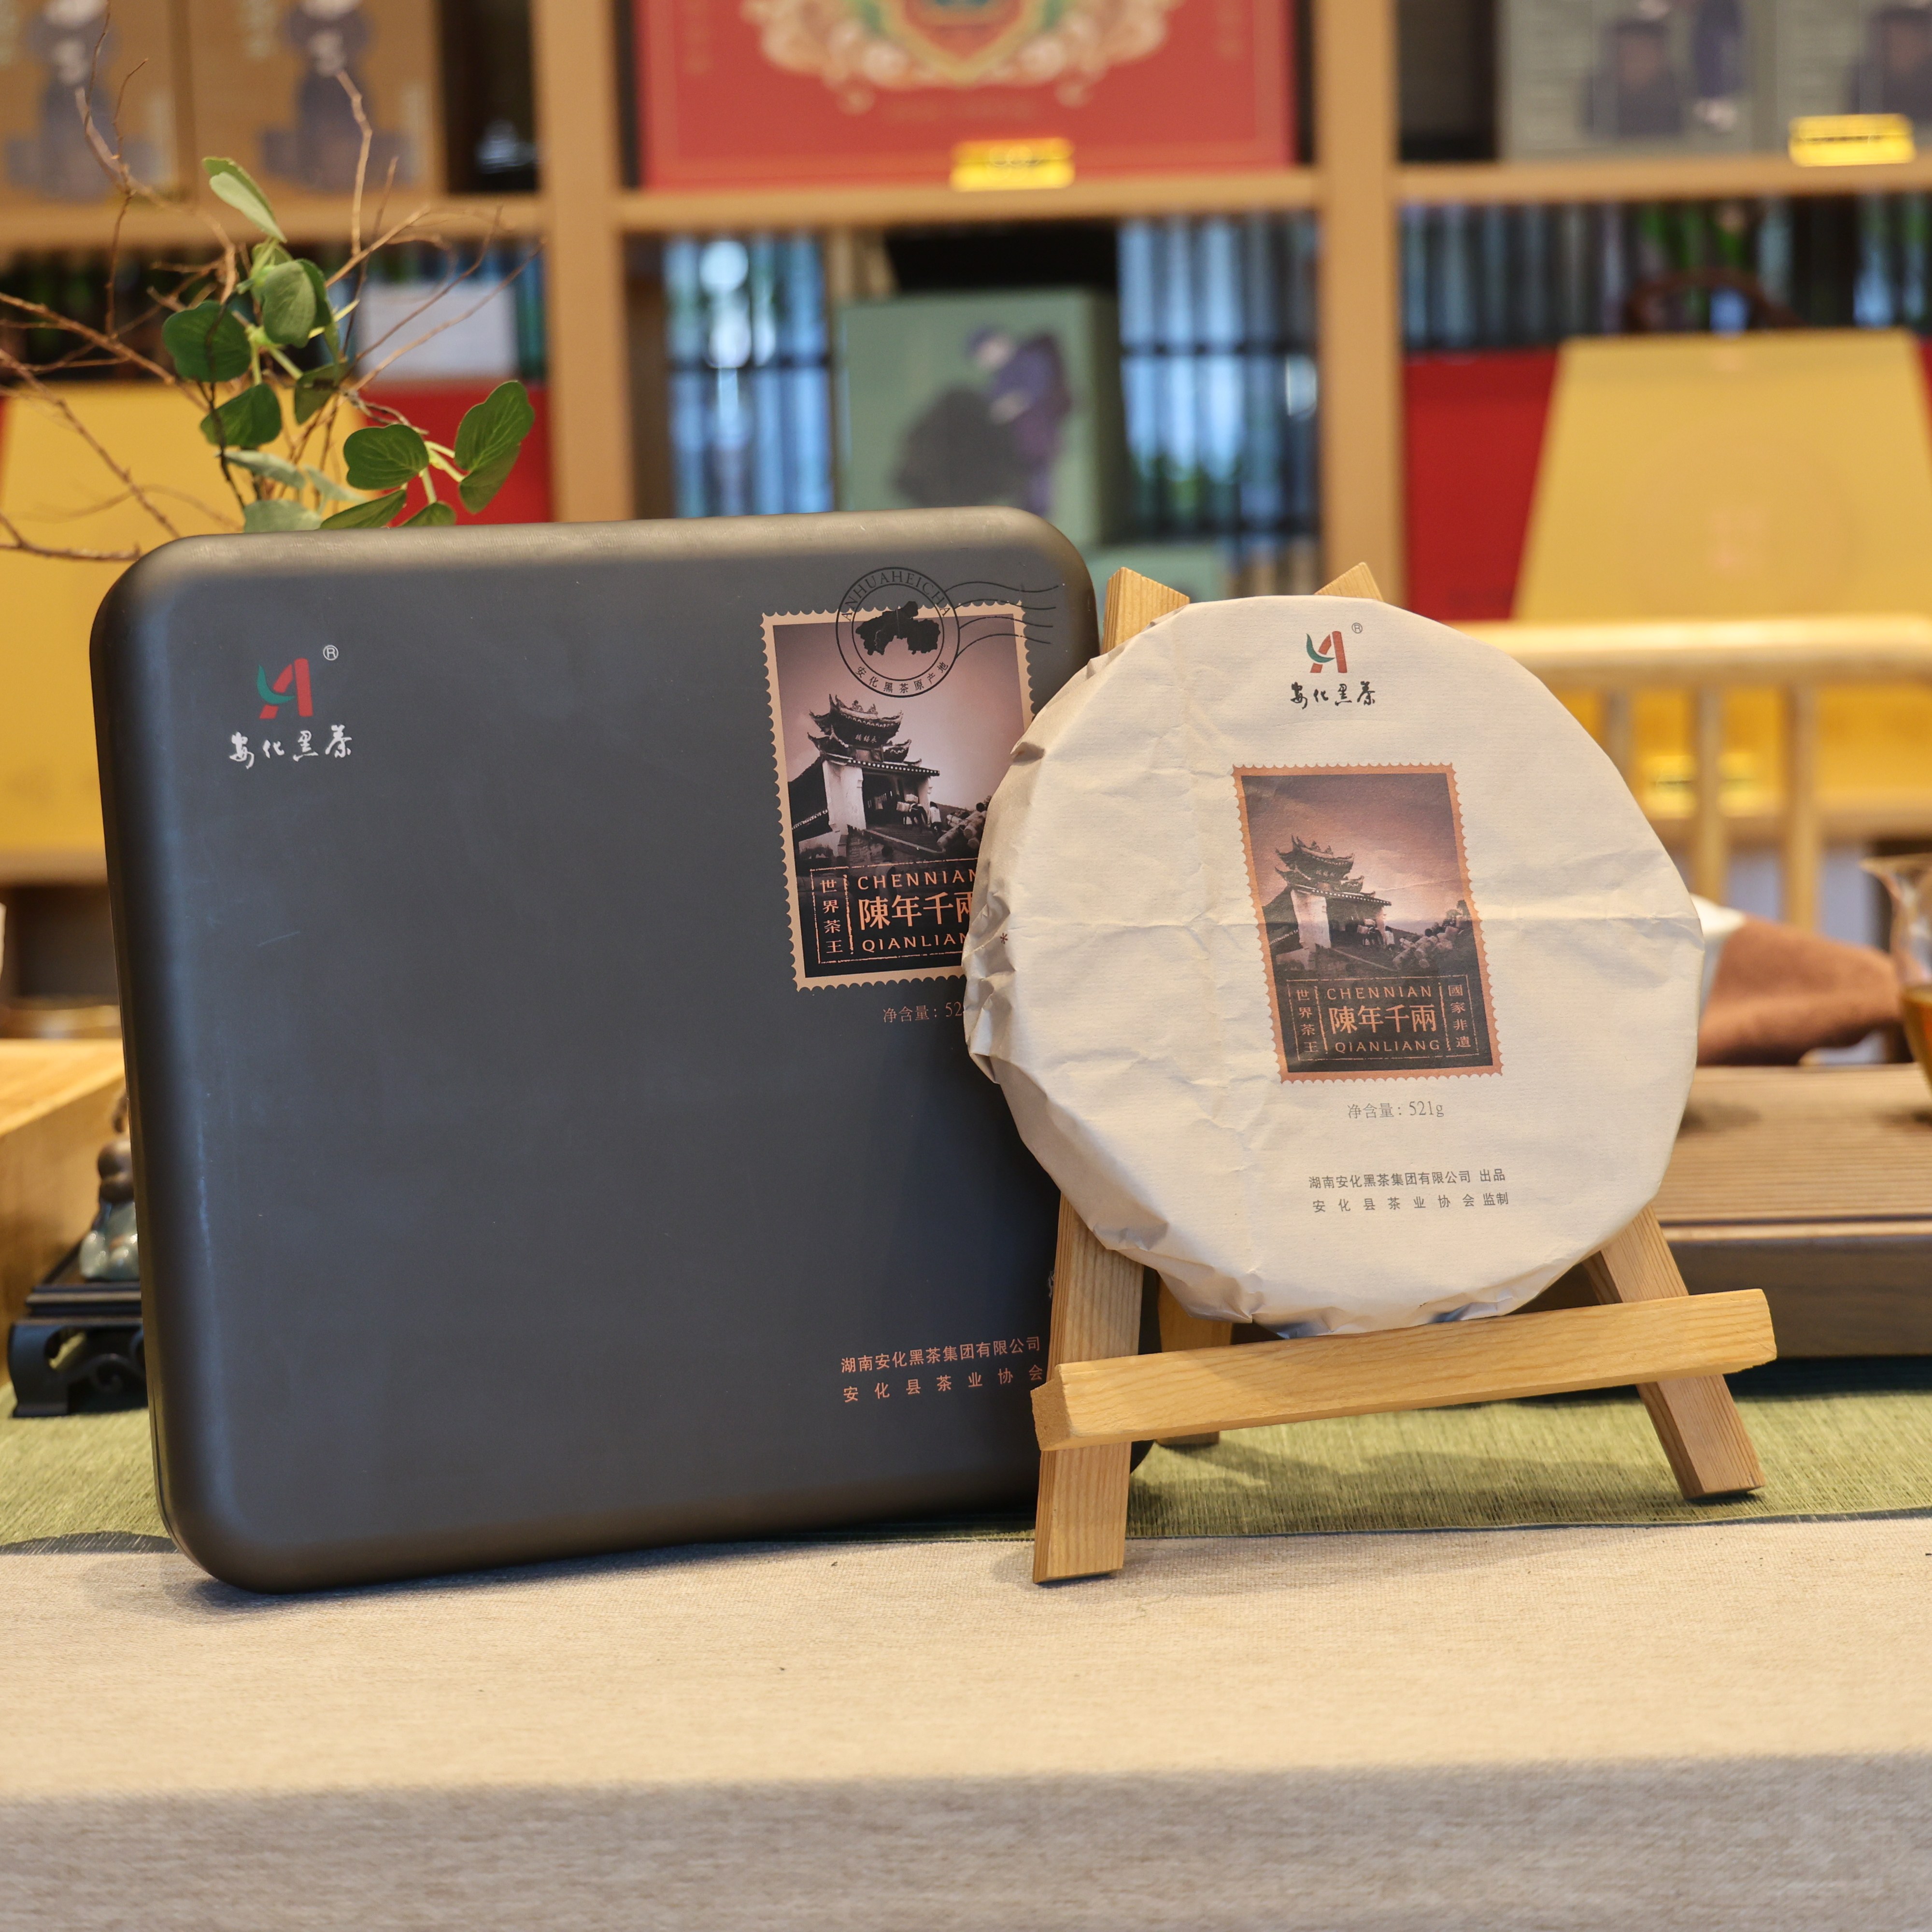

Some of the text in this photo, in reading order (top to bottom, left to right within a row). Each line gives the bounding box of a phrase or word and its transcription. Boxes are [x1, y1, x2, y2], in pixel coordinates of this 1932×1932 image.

[841, 570, 951, 622] ANHUAHEICHA
[856, 661, 949, 694] 安化黑茶原产地
[820, 879, 844, 954] 世界茶王
[1327, 985, 1432, 1000] CHENNIAN
[1296, 989, 1319, 1054] 世界茶王
[1329, 1003, 1437, 1035] 陳年千兩
[1448, 984, 1471, 1049] 國家非遺
[1335, 1039, 1440, 1054] QIANLIANG
[1309, 1168, 1506, 1189] 湖南安化黑茶集团有限公司 出品
[841, 1336, 1040, 1374] 湖南安化黑茶集团有限公司
